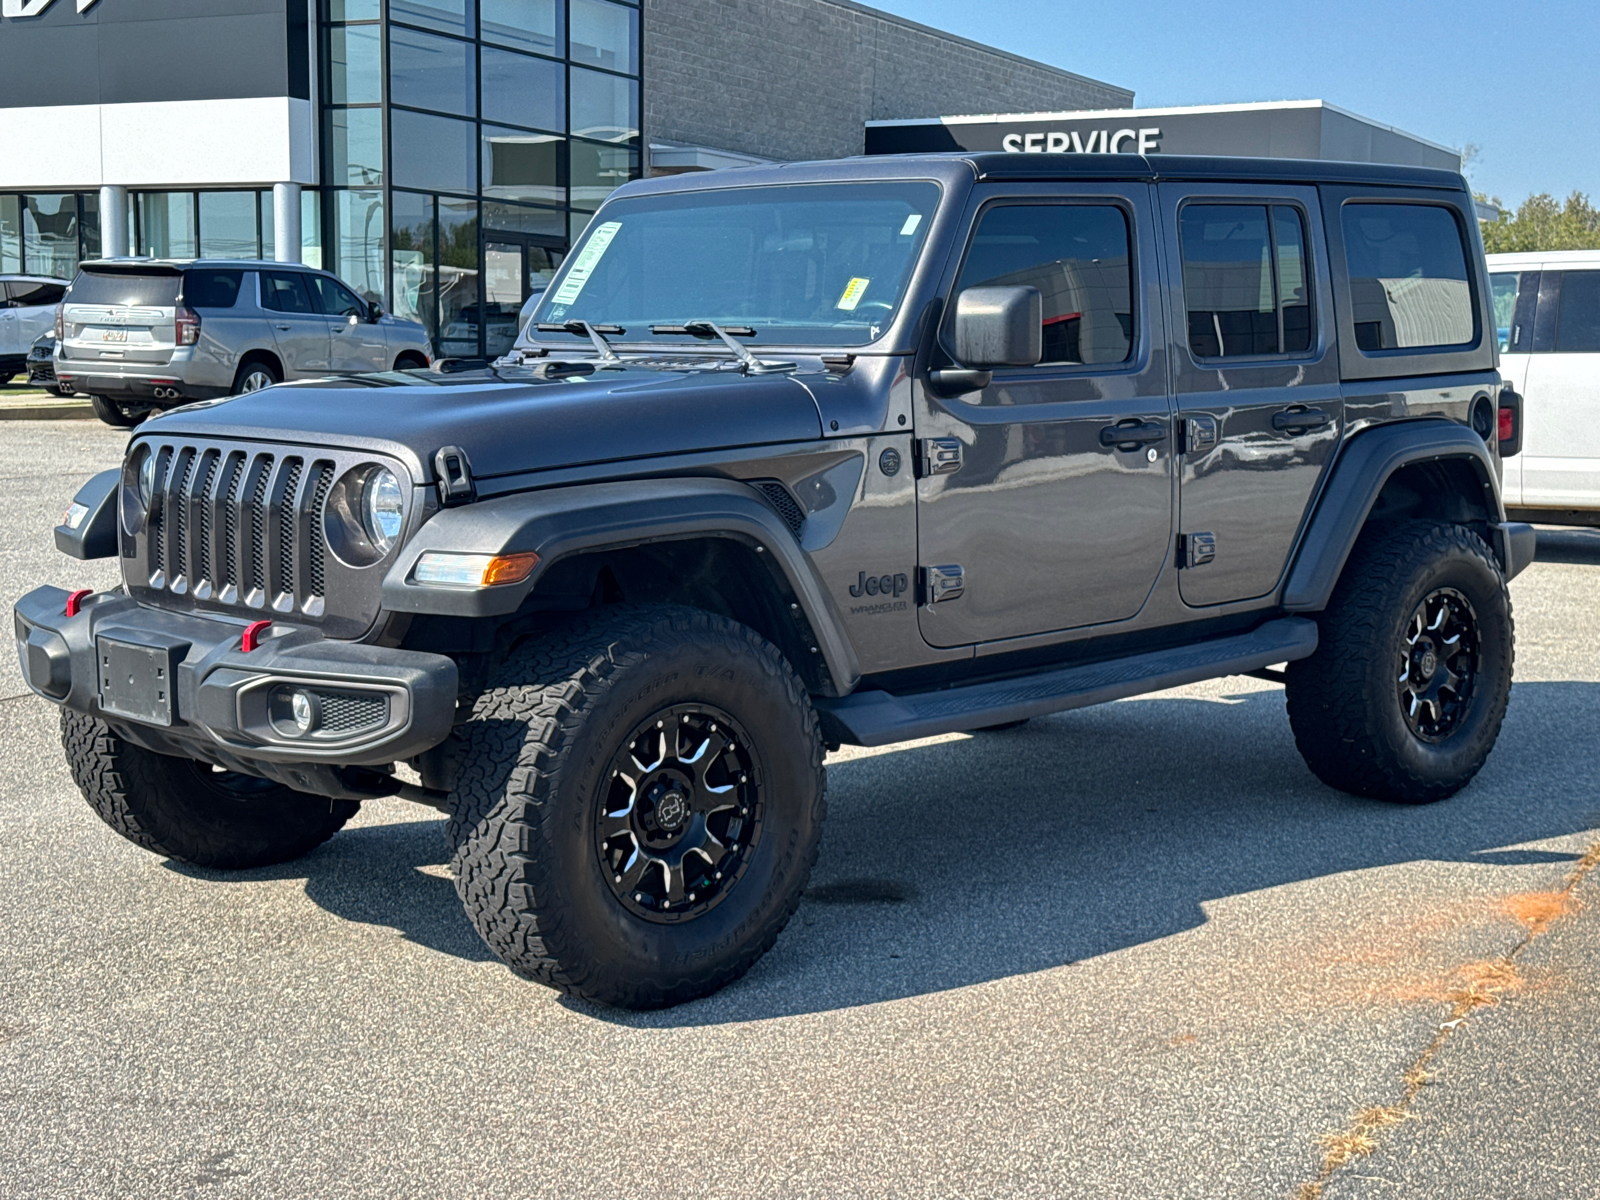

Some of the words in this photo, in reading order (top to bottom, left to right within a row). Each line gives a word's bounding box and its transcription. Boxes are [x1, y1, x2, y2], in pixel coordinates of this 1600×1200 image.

[1002, 127, 1160, 155] SERVICE
[848, 570, 909, 598] Jeep
[849, 600, 907, 614] WRANGLER
